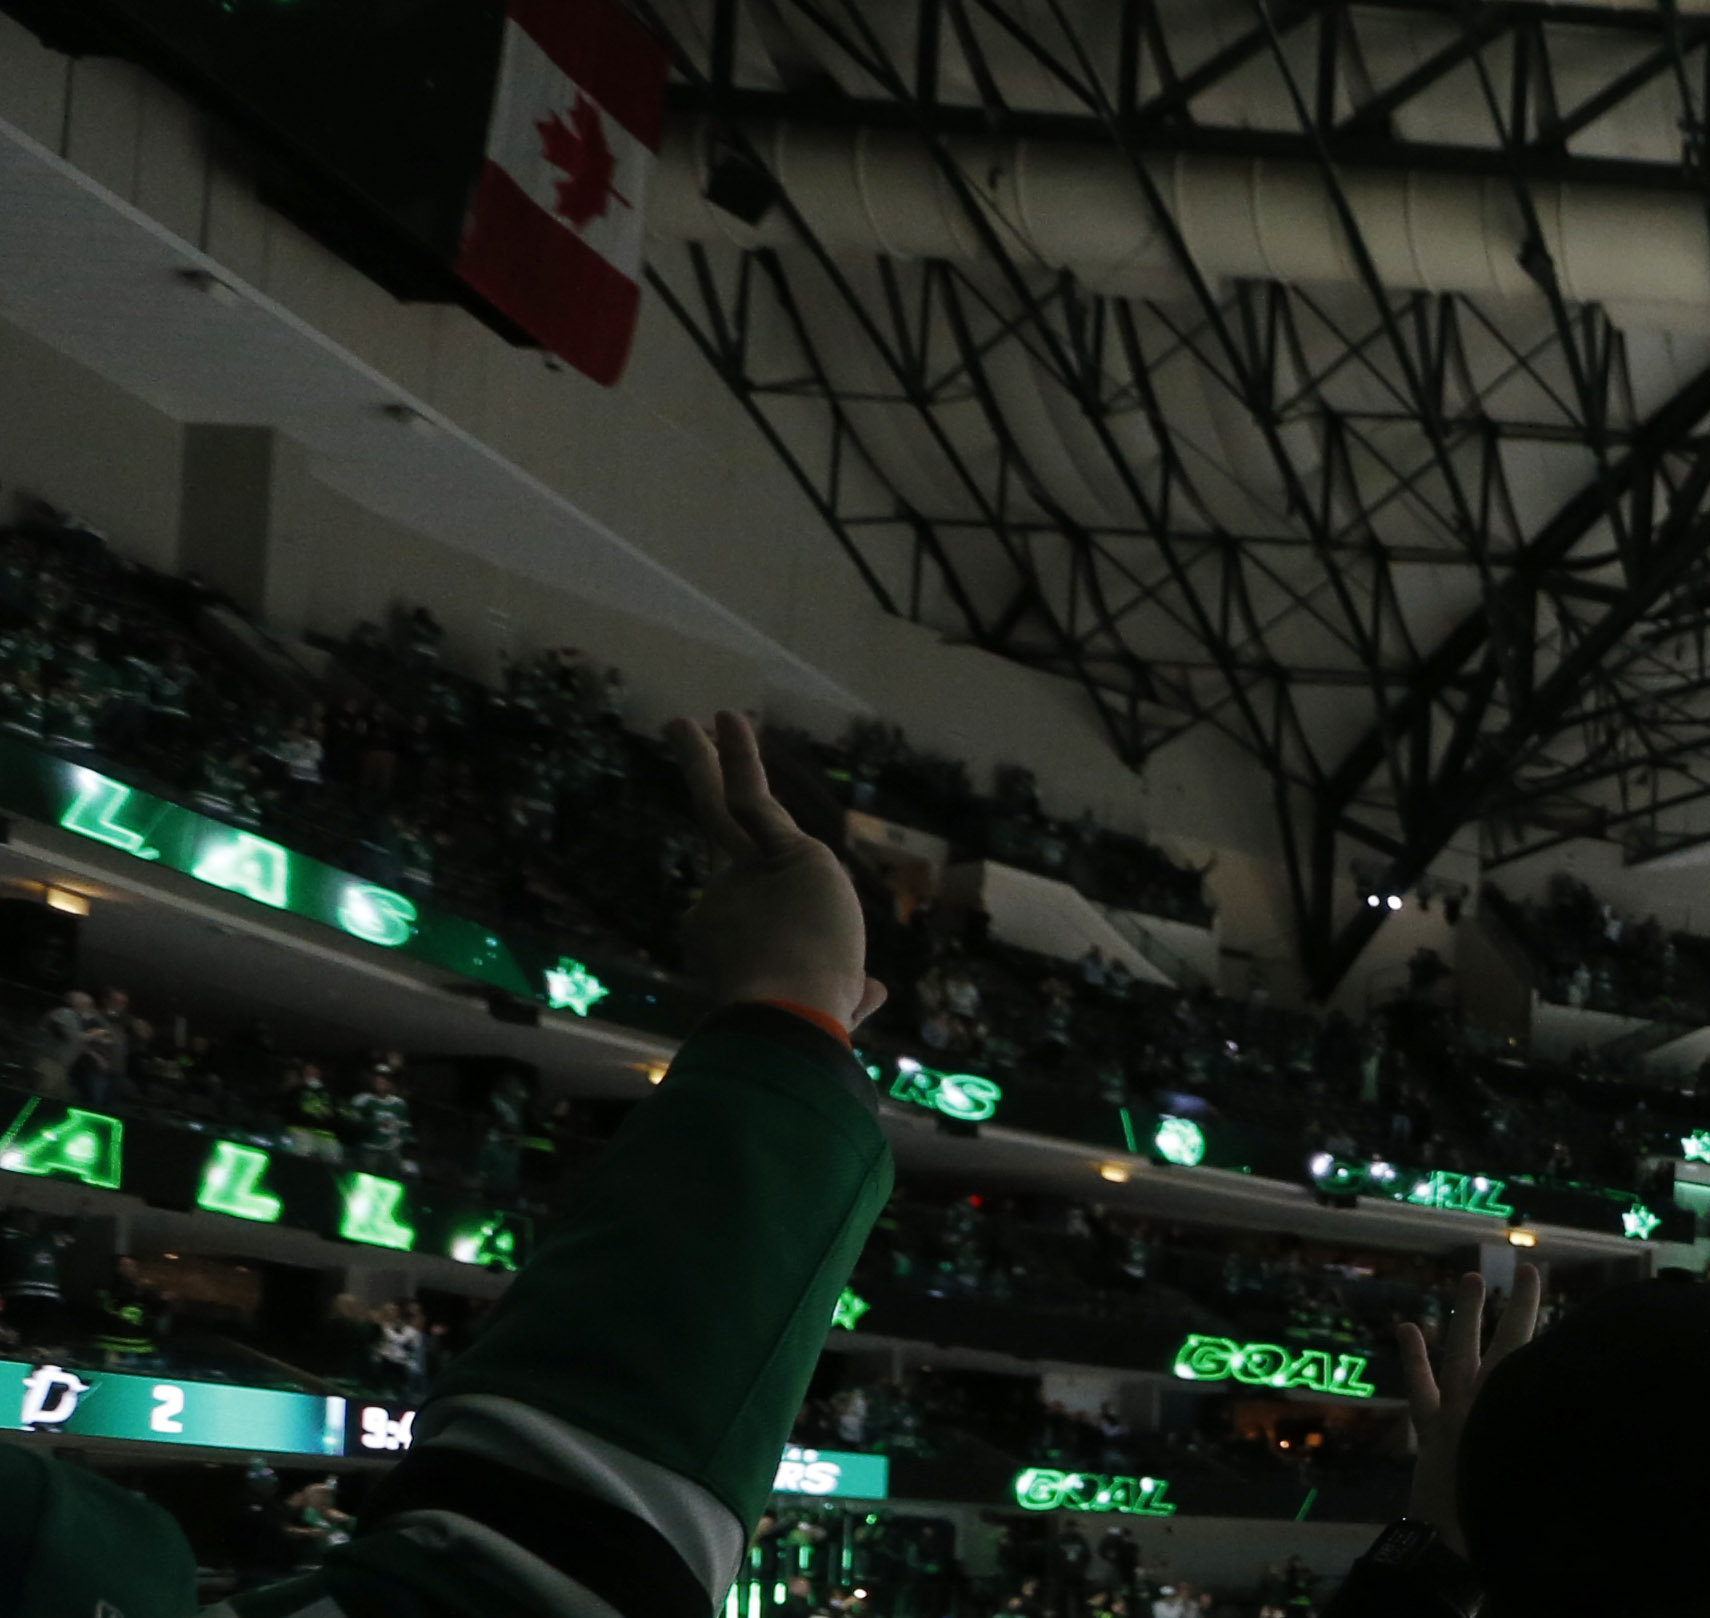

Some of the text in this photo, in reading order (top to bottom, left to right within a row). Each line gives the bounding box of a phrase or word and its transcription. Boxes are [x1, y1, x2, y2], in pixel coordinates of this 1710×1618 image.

[1173, 1333, 1376, 1399] GOAL
[149, 1384, 186, 1434] 2
[1014, 1465, 1178, 1518] GOAL
